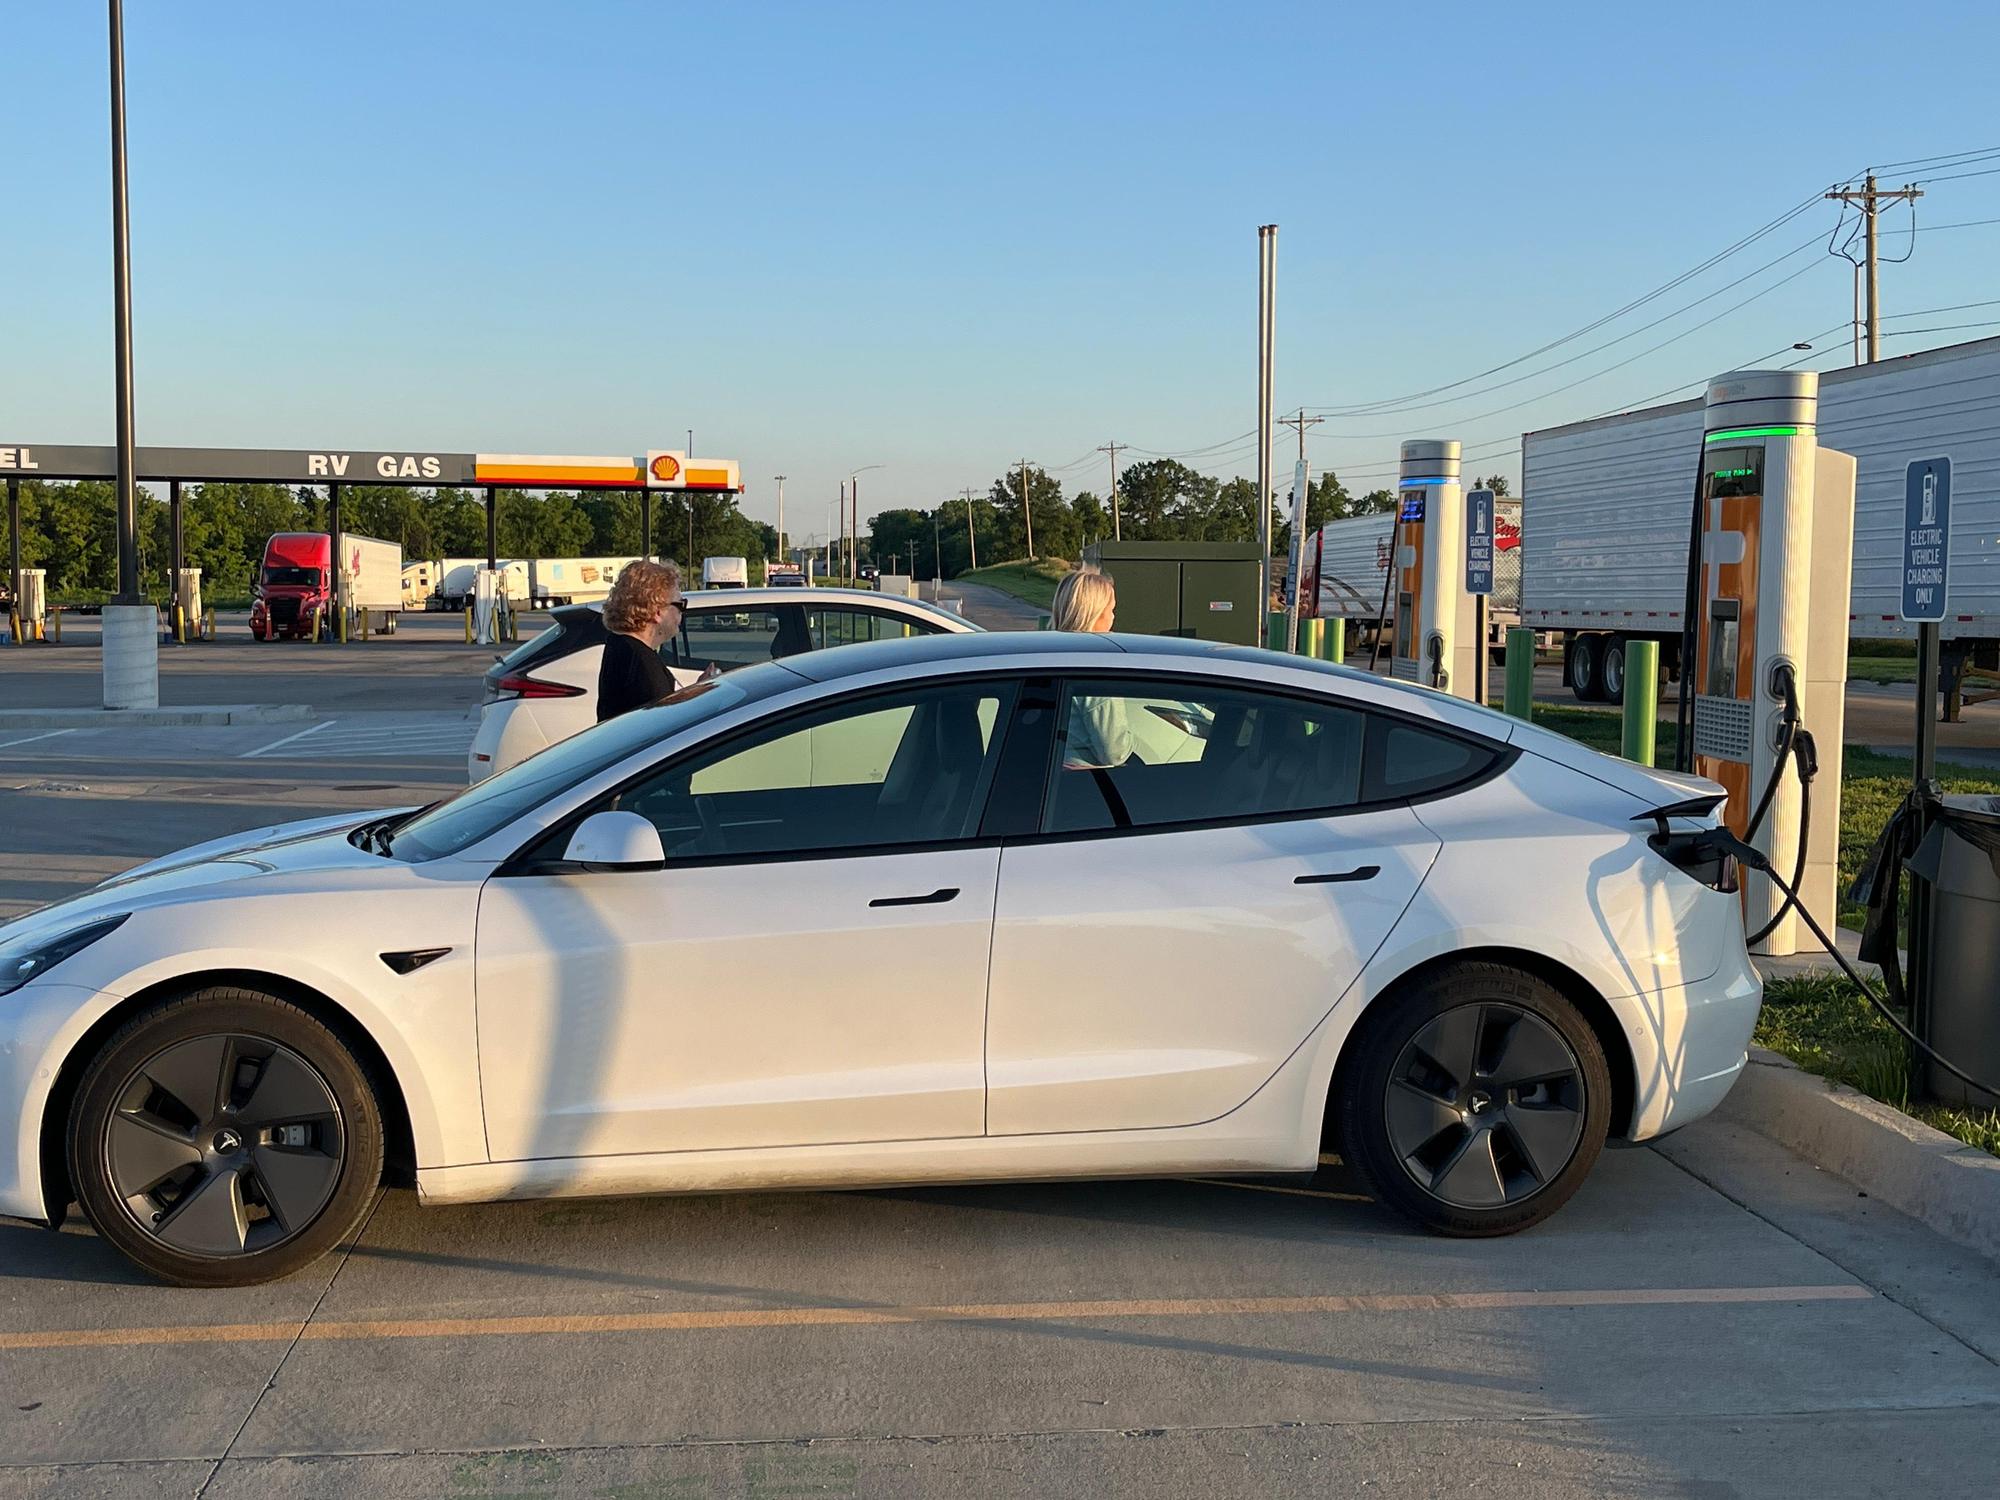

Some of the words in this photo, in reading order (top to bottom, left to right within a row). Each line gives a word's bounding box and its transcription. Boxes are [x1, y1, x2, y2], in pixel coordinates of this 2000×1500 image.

[308, 454, 350, 476] RV
[376, 455, 441, 478] GAS
[1470, 536, 1490, 547] ELECTRIC
[1910, 529, 1942, 546] ELECTRIC
[1471, 548, 1488, 559] VEHICLE
[1911, 548, 1940, 565] VEHICLE
[1469, 560, 1490, 572] CHARGING
[1907, 568, 1942, 585] CHARGING
[1915, 587, 1933, 604] ONLY
